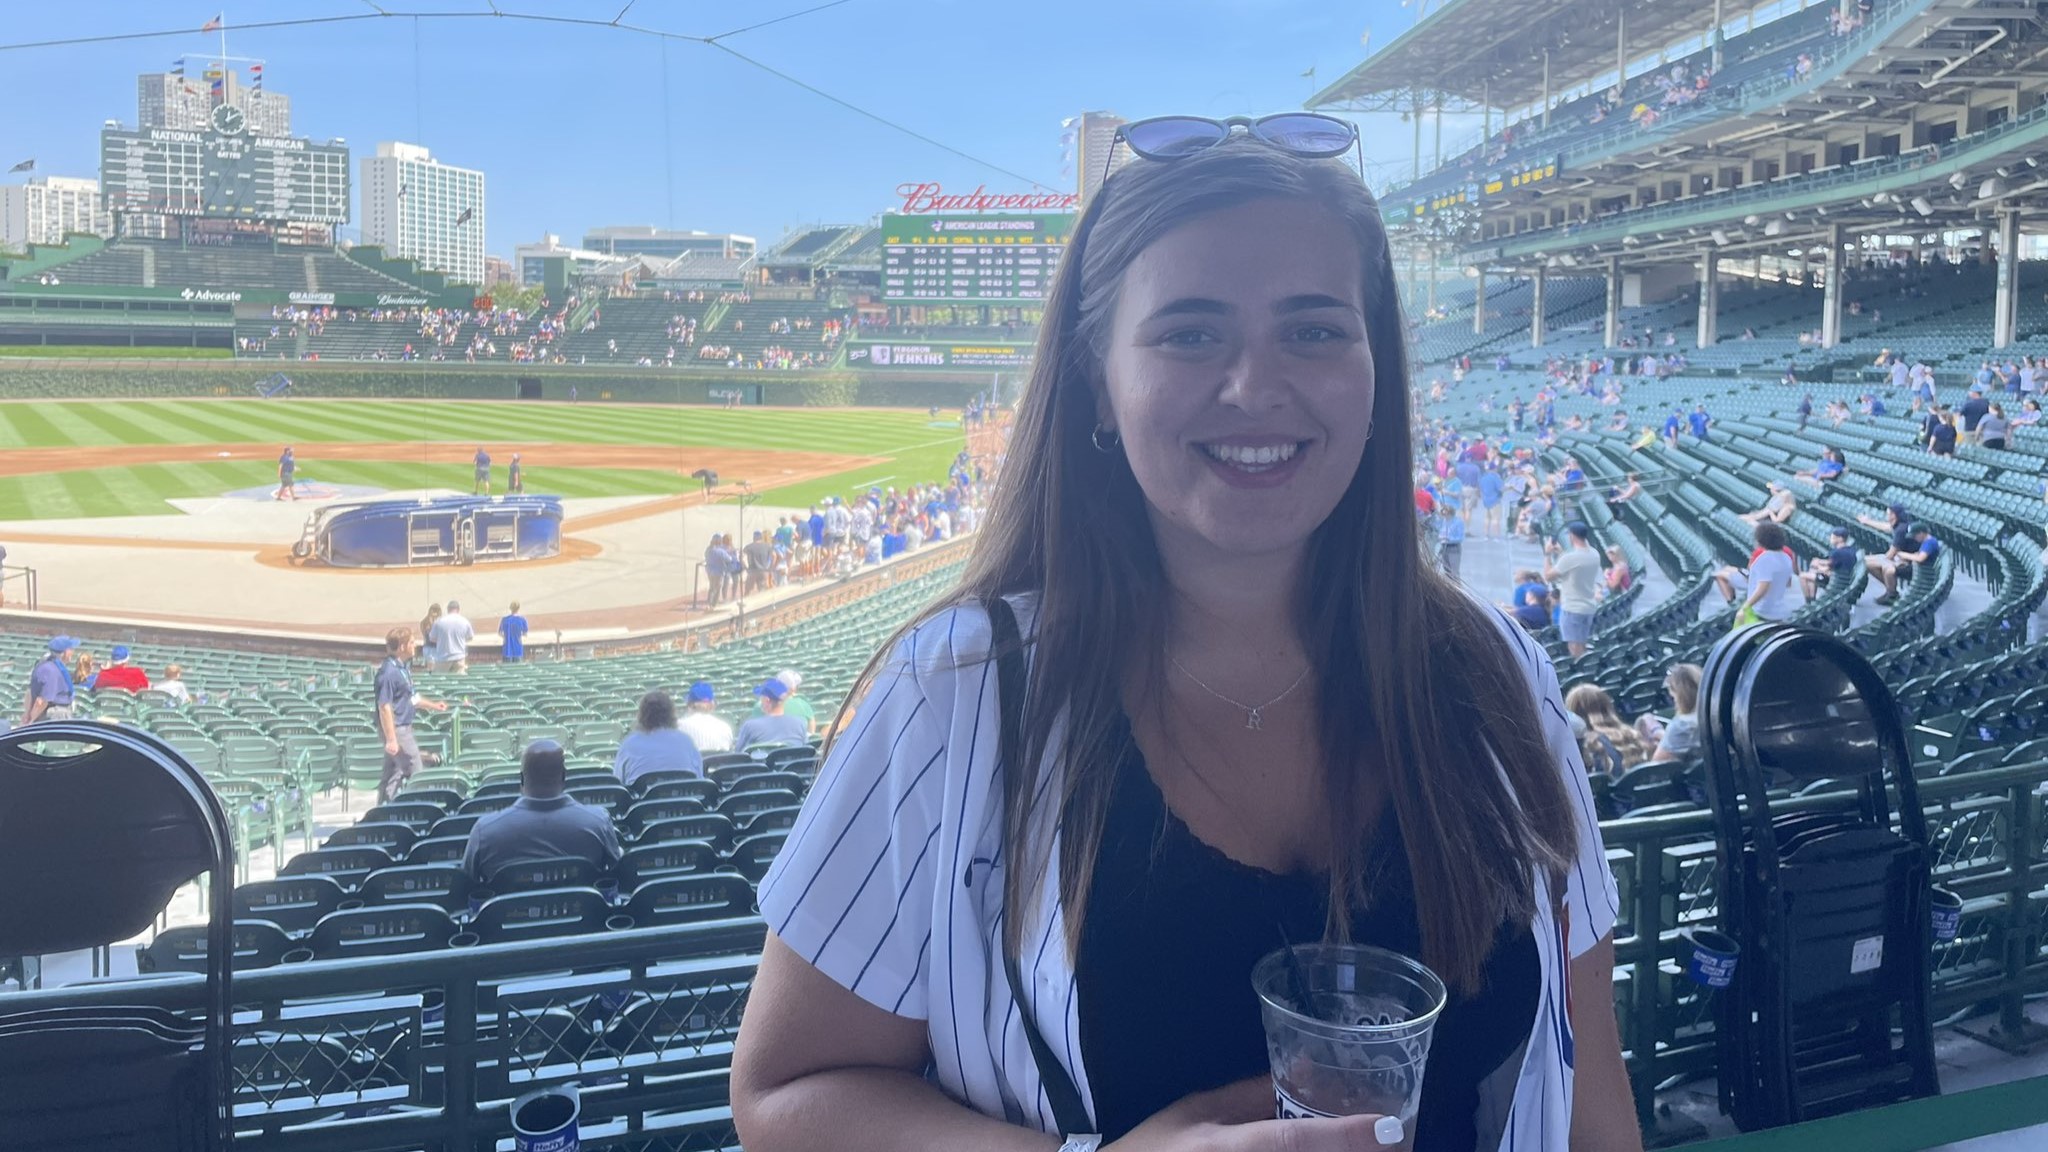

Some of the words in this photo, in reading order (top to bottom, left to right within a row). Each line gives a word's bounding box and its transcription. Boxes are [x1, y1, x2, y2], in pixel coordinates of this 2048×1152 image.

[151, 130, 203, 143] NATIONAL
[255, 137, 304, 150] AMERICAN
[896, 182, 1079, 213] Budweiser
[195, 289, 241, 302] Advocate
[376, 293, 428, 305] Budweiser
[893, 353, 945, 365] JENKINS
